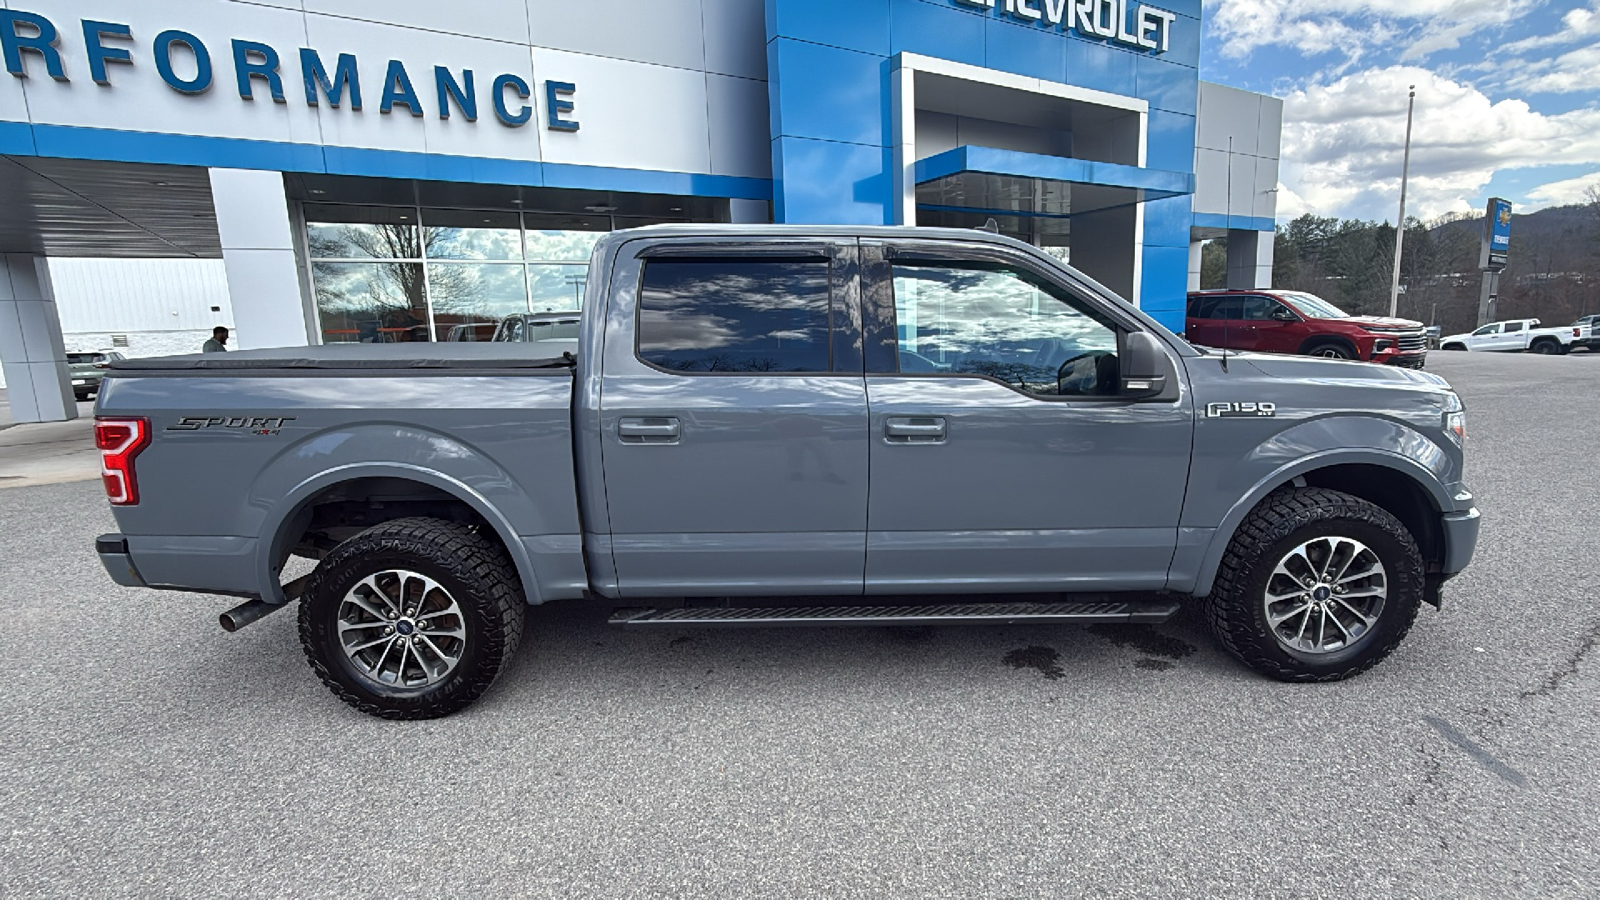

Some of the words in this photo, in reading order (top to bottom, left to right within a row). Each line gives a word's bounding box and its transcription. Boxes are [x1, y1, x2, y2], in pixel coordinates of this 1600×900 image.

[961, 0, 1176, 53] VROLET
[0, 8, 581, 132] RFORMANCE
[166, 416, 297, 430] SPORT
